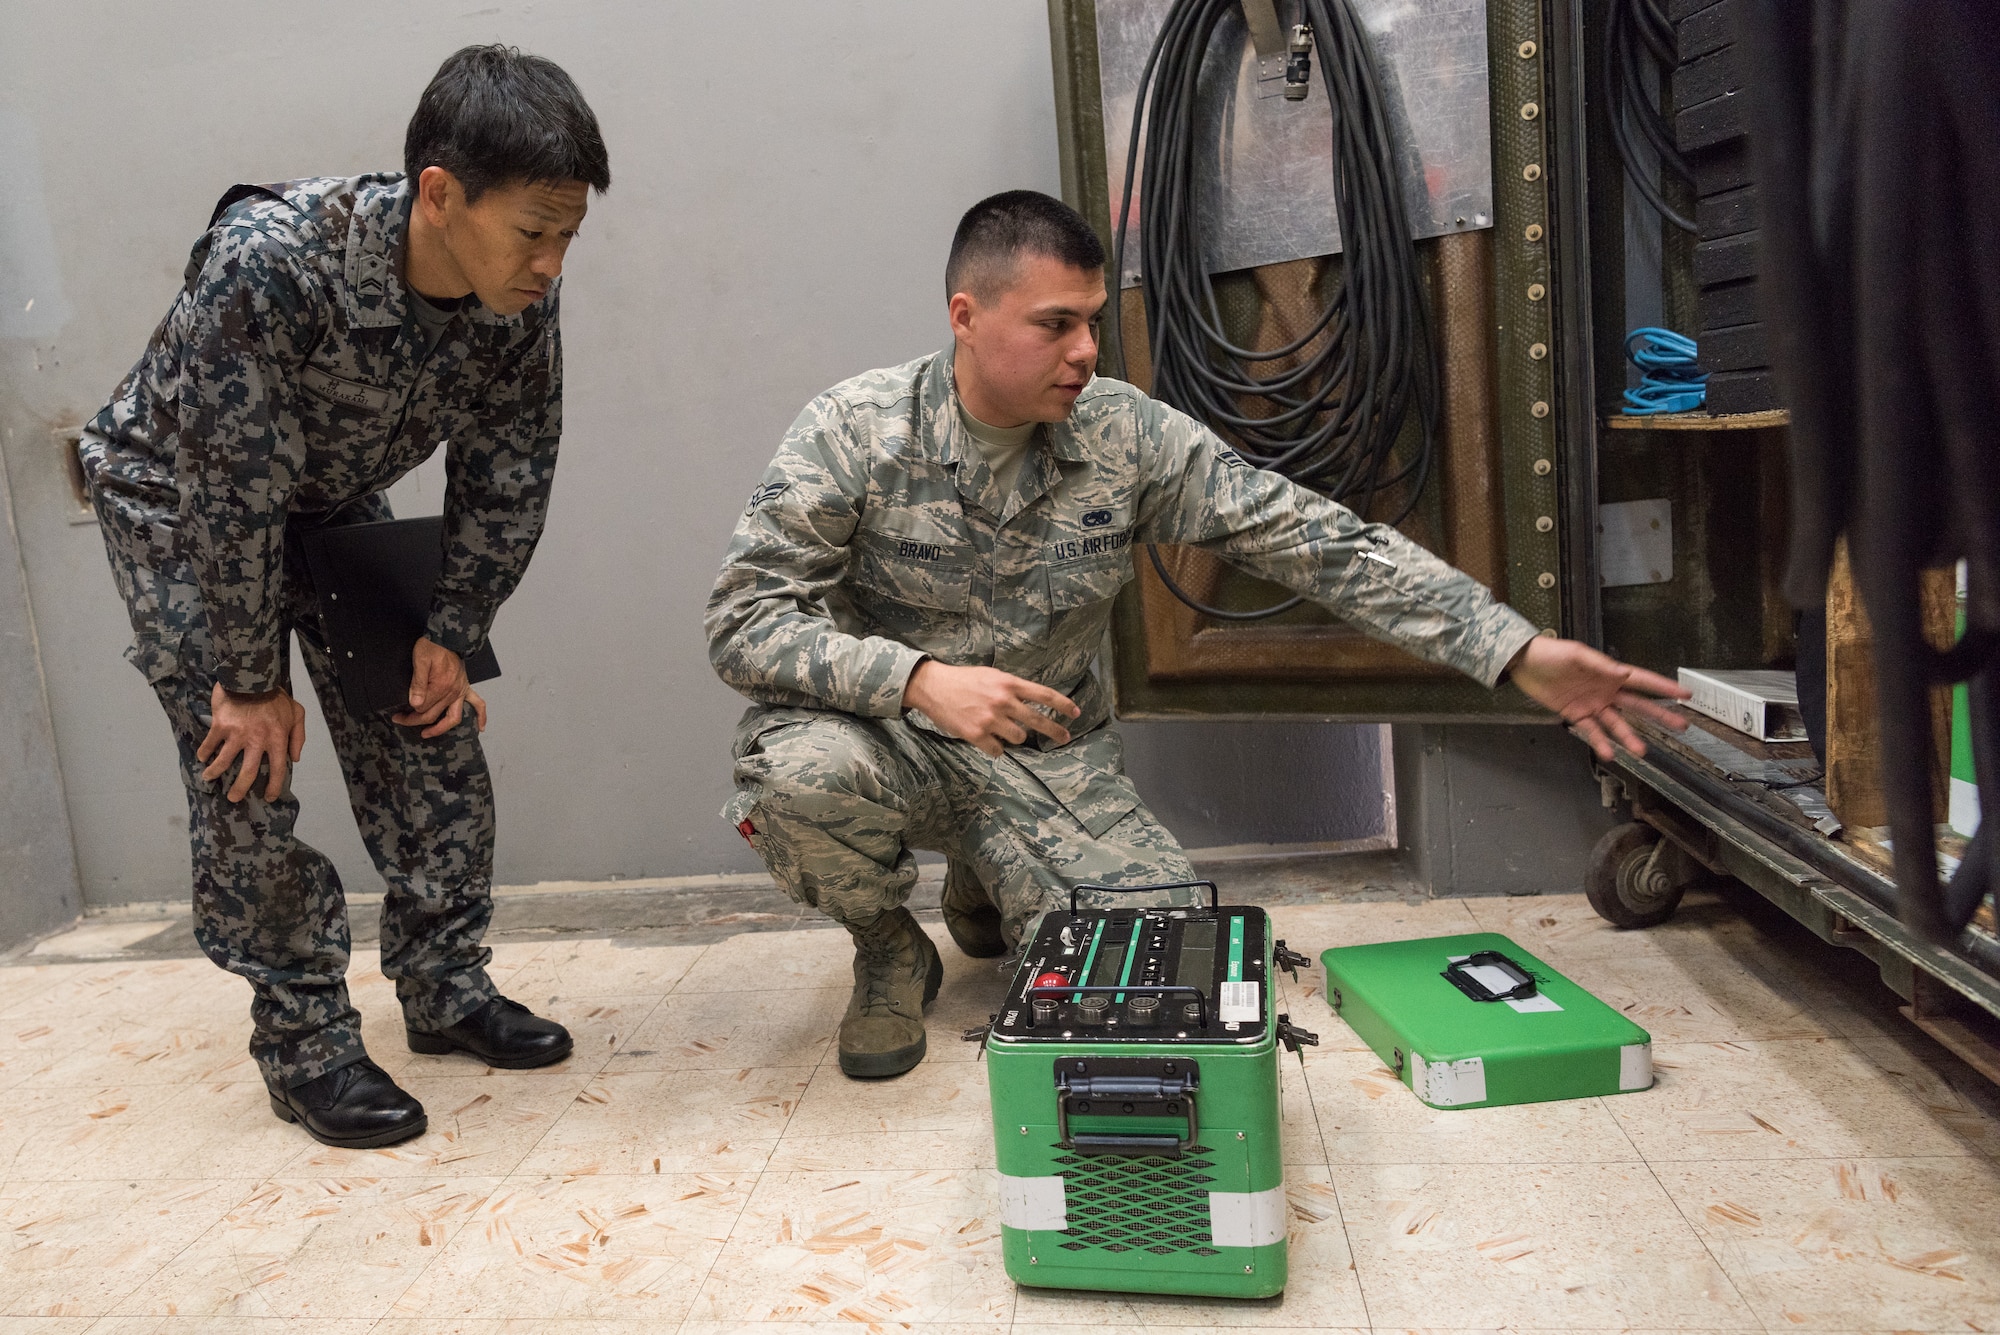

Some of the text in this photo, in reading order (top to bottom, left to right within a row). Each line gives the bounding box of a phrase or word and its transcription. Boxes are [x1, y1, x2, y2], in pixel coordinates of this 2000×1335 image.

[319, 385, 368, 405] MURAKAMI
[900, 542, 940, 560] BRAVO
[1055, 529, 1131, 560] U.S. AIR FOR
